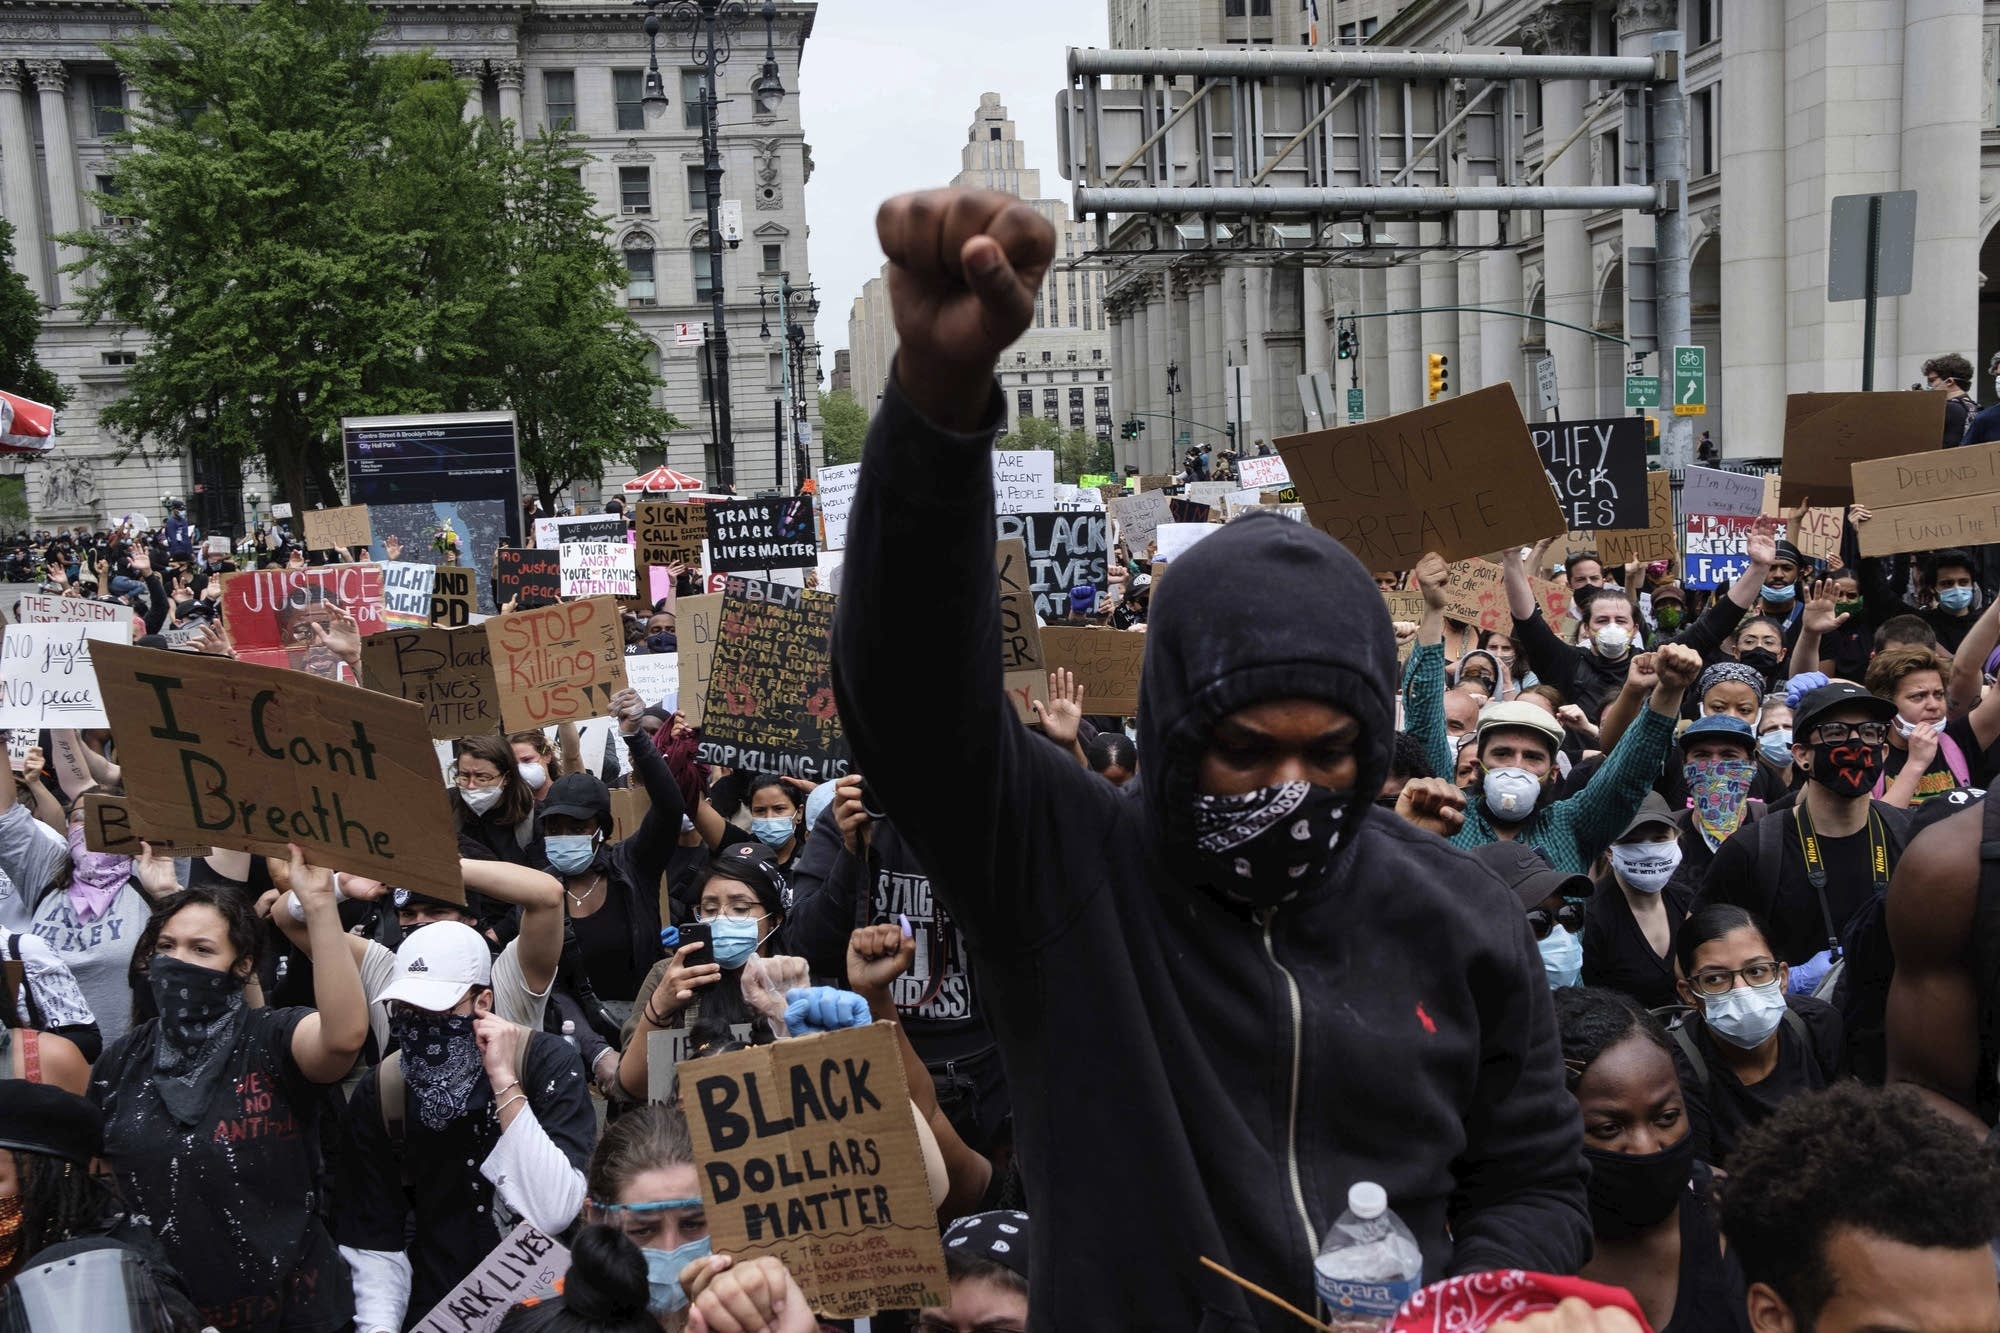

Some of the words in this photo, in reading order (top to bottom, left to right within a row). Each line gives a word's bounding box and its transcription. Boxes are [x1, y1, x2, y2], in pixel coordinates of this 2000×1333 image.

[1644, 388, 1656, 396] Italy
[998, 455, 1023, 468] ARE
[1242, 457, 1279, 470] LATINX
[819, 468, 845, 481] THOSE
[1256, 467, 1272, 476] FOR
[1265, 473, 1286, 483] LIVES
[1897, 465, 1978, 489] DEFUND
[1008, 486, 1045, 499] PEOPLE
[1280, 490, 1294, 501] NO
[823, 499, 845, 508] WILL
[314, 509, 357, 525] BLACK
[643, 507, 688, 525] SIGN
[716, 506, 770, 525] TRANS
[568, 525, 581, 533] WE
[590, 523, 620, 531] WANT
[643, 529, 678, 542] CALL
[717, 525, 773, 541] BLACK
[1894, 519, 1952, 541] FUND
[312, 531, 364, 547] MATTER
[1604, 532, 1674, 561] MATTER
[563, 545, 571, 557] IF
[643, 548, 690, 563] DONATE
[714, 545, 756, 560] LIVES
[758, 543, 816, 558] MATTER
[580, 556, 617, 567] ANGRY
[502, 574, 520, 585] no
[601, 568, 636, 582] PAYING
[243, 567, 381, 612] JUSTICE
[521, 583, 561, 600] peace
[570, 580, 630, 594] ATTENTION
[726, 579, 801, 611] #BLM
[24, 596, 52, 616] THE
[61, 600, 116, 621] SYSTEM
[345, 603, 385, 623] FOR
[501, 600, 595, 652] STOP
[5, 635, 33, 659] NO
[41, 627, 89, 674] just
[394, 634, 493, 676] Black
[0, 679, 33, 708] NO
[41, 689, 92, 721] peace
[428, 700, 491, 724] ATTER
[134, 671, 200, 744] I
[251, 689, 378, 780] Cant
[696, 742, 737, 766] STOP
[738, 749, 819, 780] KILLING
[822, 759, 849, 781] US
[179, 748, 395, 859] Breathe
[1807, 837, 1818, 863] Nikon
[1874, 846, 1885, 873] Nikon
[696, 1058, 882, 1152] BLACK
[705, 1138, 880, 1204] DOLLARS
[743, 1184, 892, 1241] MATTER
[486, 1228, 554, 1292] LIVES
